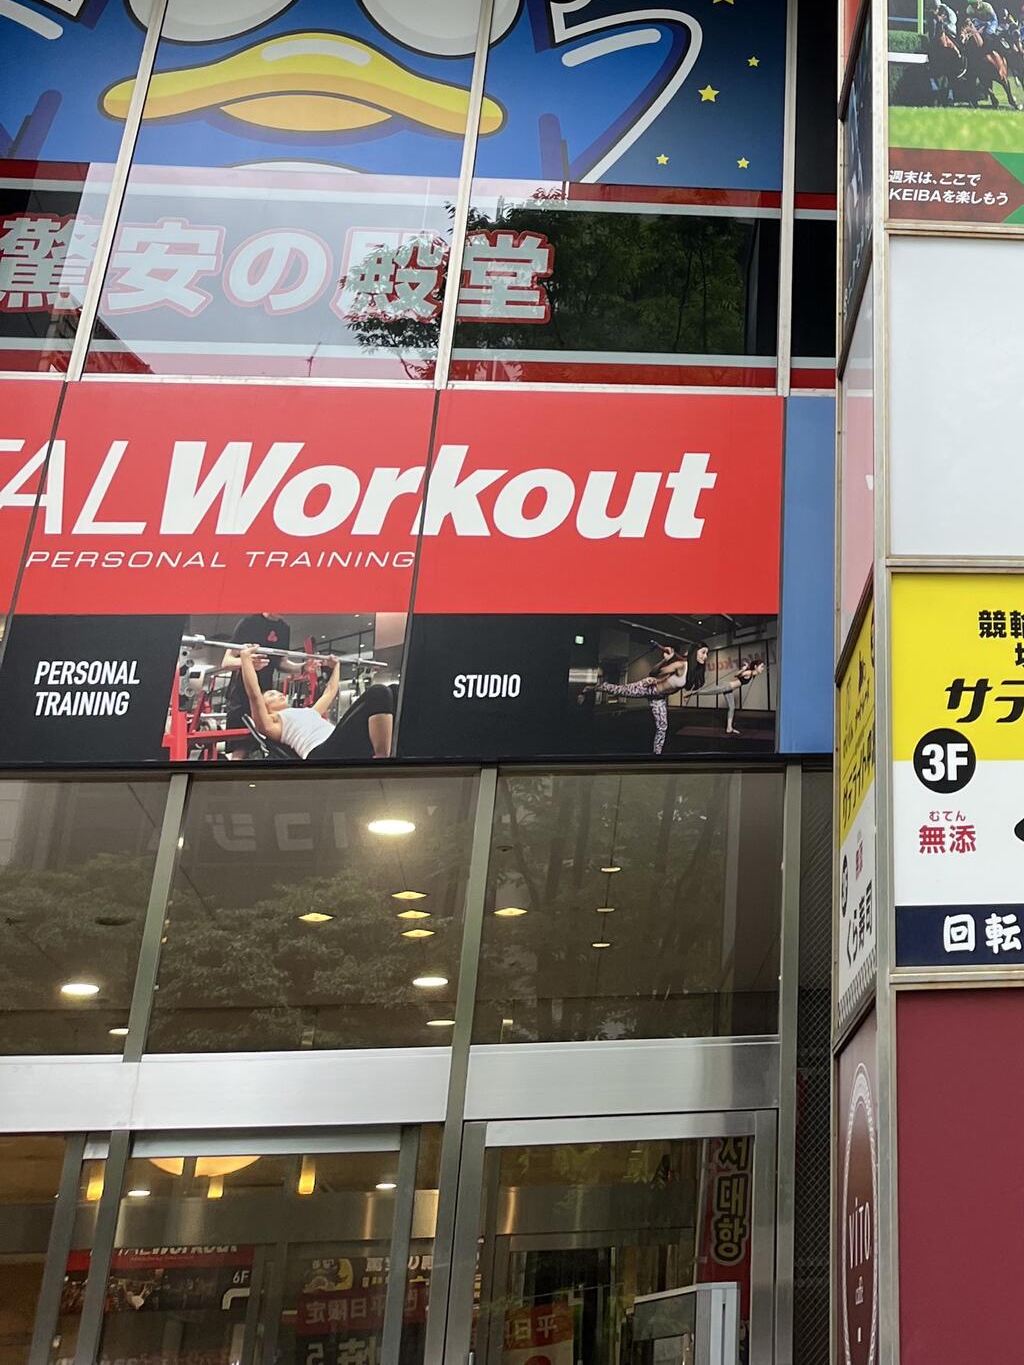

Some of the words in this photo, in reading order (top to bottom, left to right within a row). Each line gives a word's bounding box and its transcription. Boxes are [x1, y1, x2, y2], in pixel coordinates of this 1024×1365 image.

[889, 188, 1009, 205] KEIBAを楽しもう
[25, 551, 227, 568] PERSONAL
[245, 551, 416, 568] TRAINING
[34, 660, 141, 687] PERSONAL
[452, 674, 521, 699] STUDIO
[34, 690, 131, 717] TRAINING
[921, 743, 970, 781] 3F
[929, 810, 966, 822] むてん
[918, 823, 977, 855] 無添
